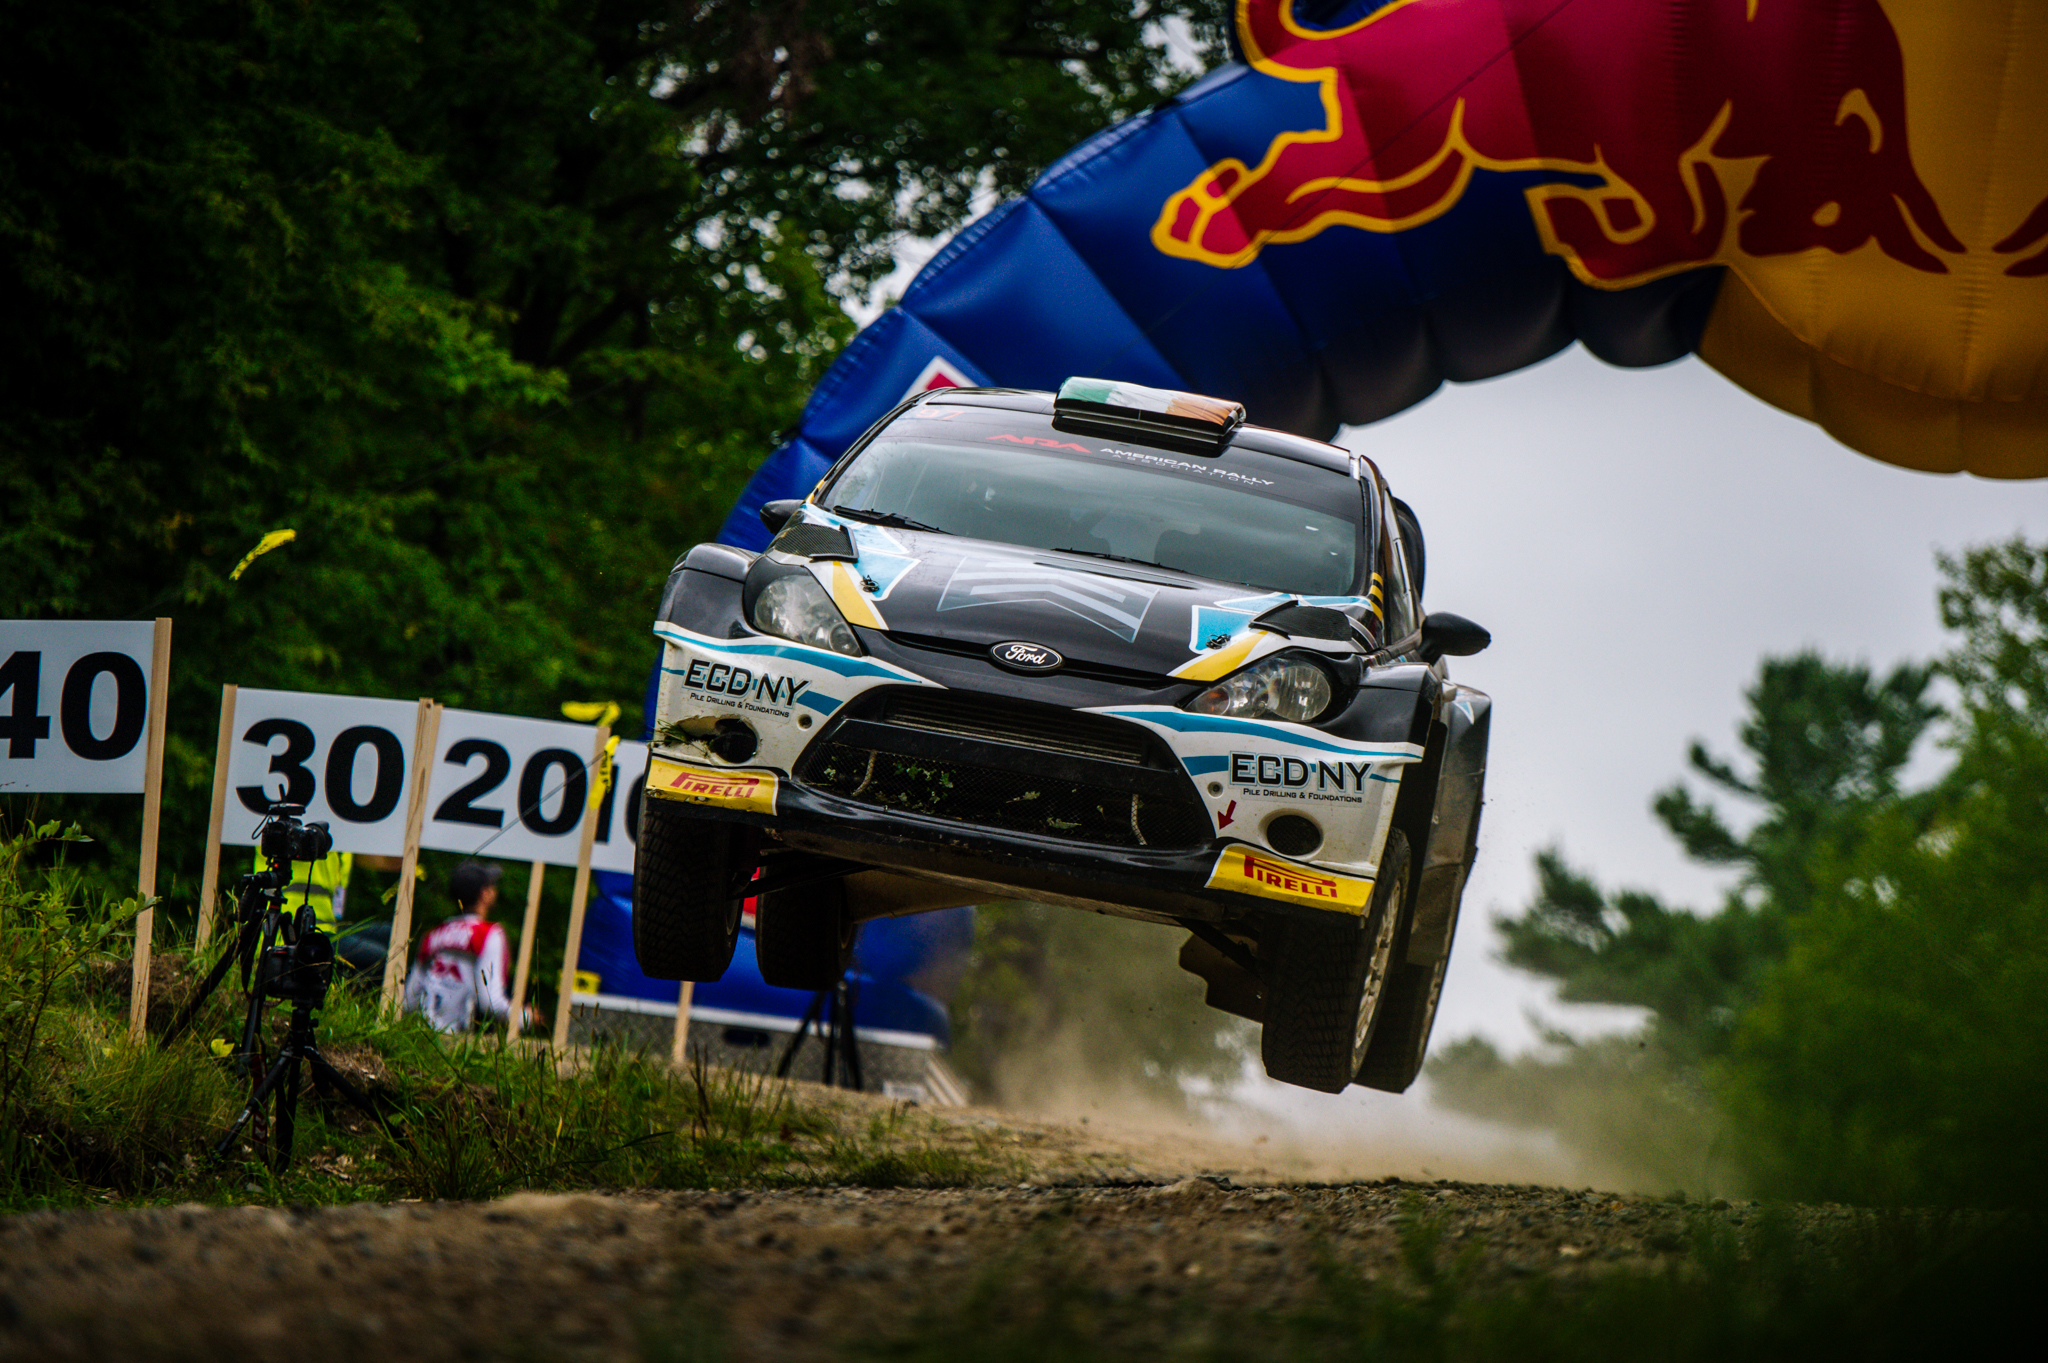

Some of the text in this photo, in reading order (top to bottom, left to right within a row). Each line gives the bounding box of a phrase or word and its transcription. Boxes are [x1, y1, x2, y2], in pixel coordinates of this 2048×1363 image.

[985, 434, 1092, 453] ARA
[1100, 448, 1274, 486] AMERICAN RALLY
[1005, 645, 1047, 665] Ford
[235, 718, 405, 823] 30
[433, 738, 588, 836] 20
[670, 772, 760, 798] PIRELLI
[1244, 855, 1338, 898] PIRELLI
